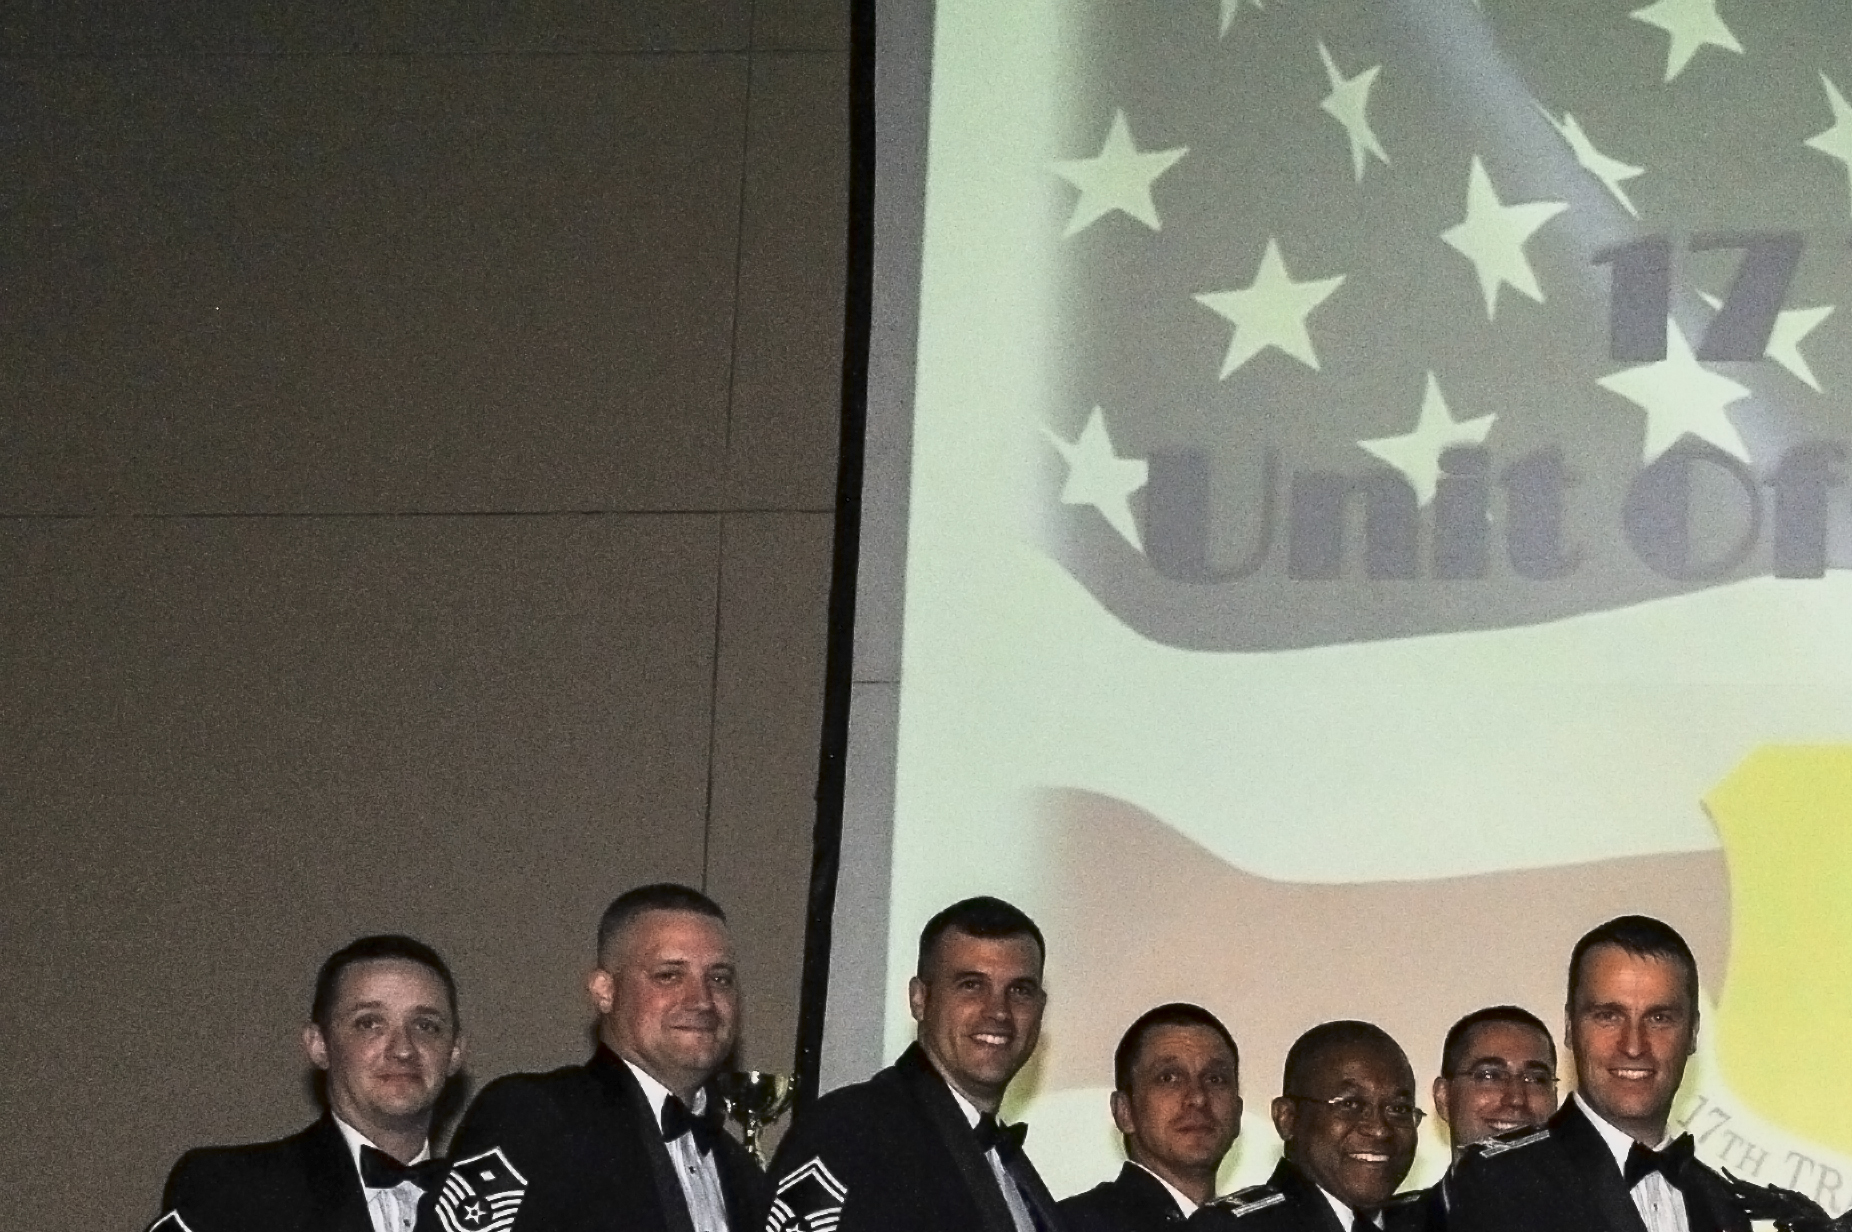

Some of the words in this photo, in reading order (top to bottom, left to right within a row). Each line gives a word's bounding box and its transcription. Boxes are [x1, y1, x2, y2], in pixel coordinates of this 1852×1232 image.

[1591, 232, 1806, 362] 17
[1146, 444, 1583, 584] Unit
[1622, 440, 1846, 582] Of
[1676, 1094, 1768, 1178] 17TH
